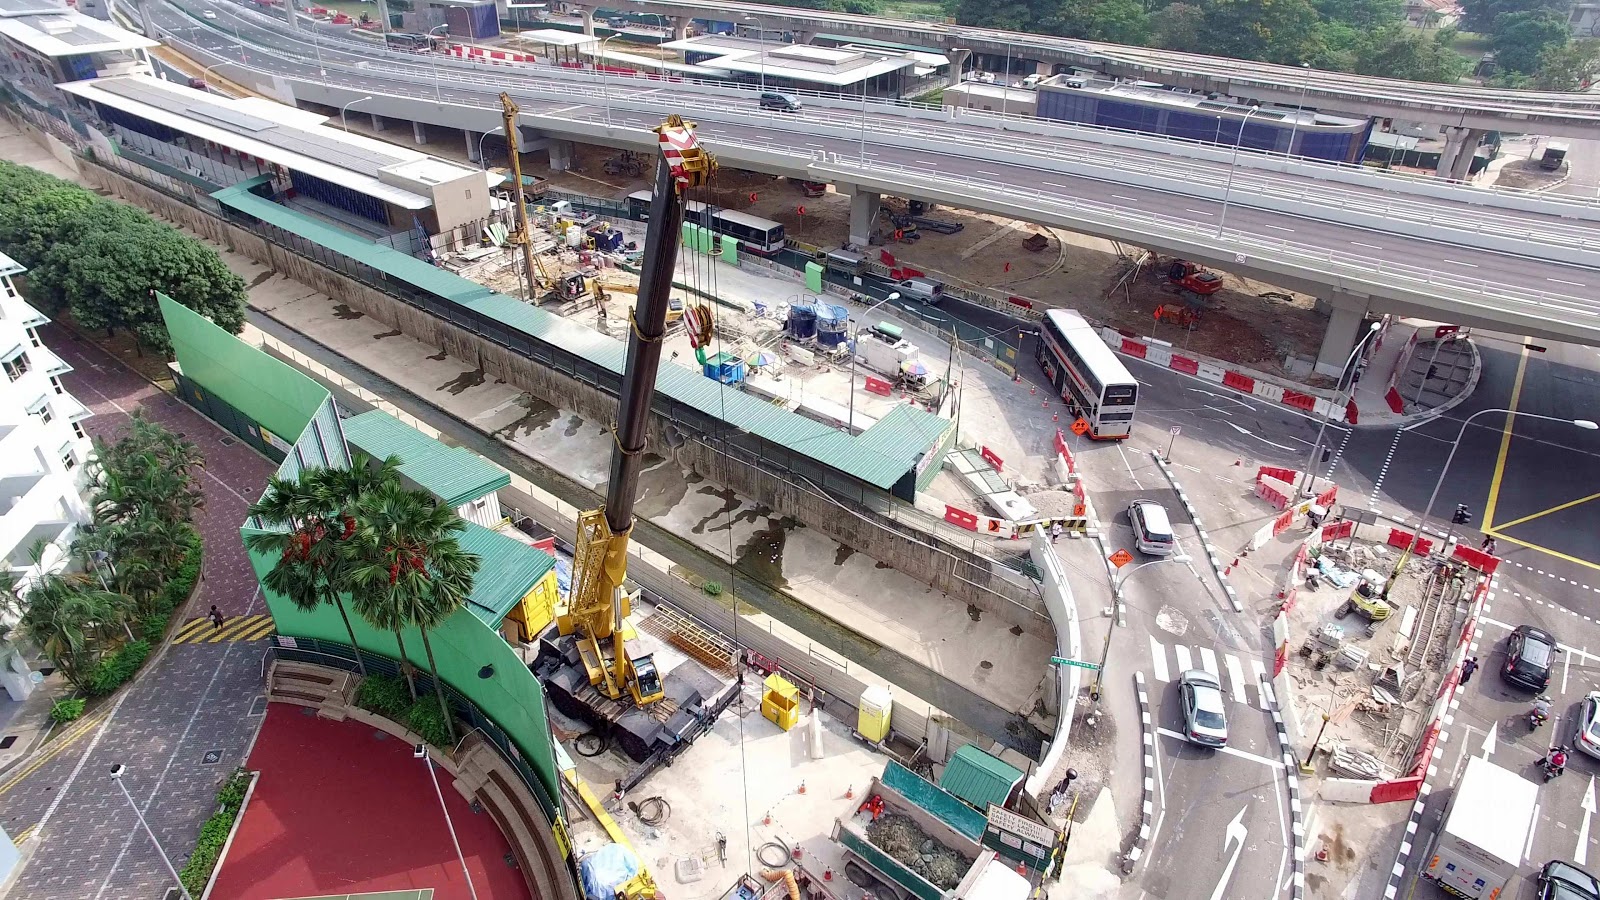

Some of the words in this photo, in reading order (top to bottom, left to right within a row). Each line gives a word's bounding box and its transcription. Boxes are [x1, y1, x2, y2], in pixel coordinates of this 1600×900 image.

[991, 817, 1014, 830] SAFETY
[991, 813, 1014, 825] SAFETY
[1017, 823, 1040, 836] LAST!!!
[992, 808, 1016, 821] SAFETY
[1018, 819, 1043, 832] FIRST!!!
